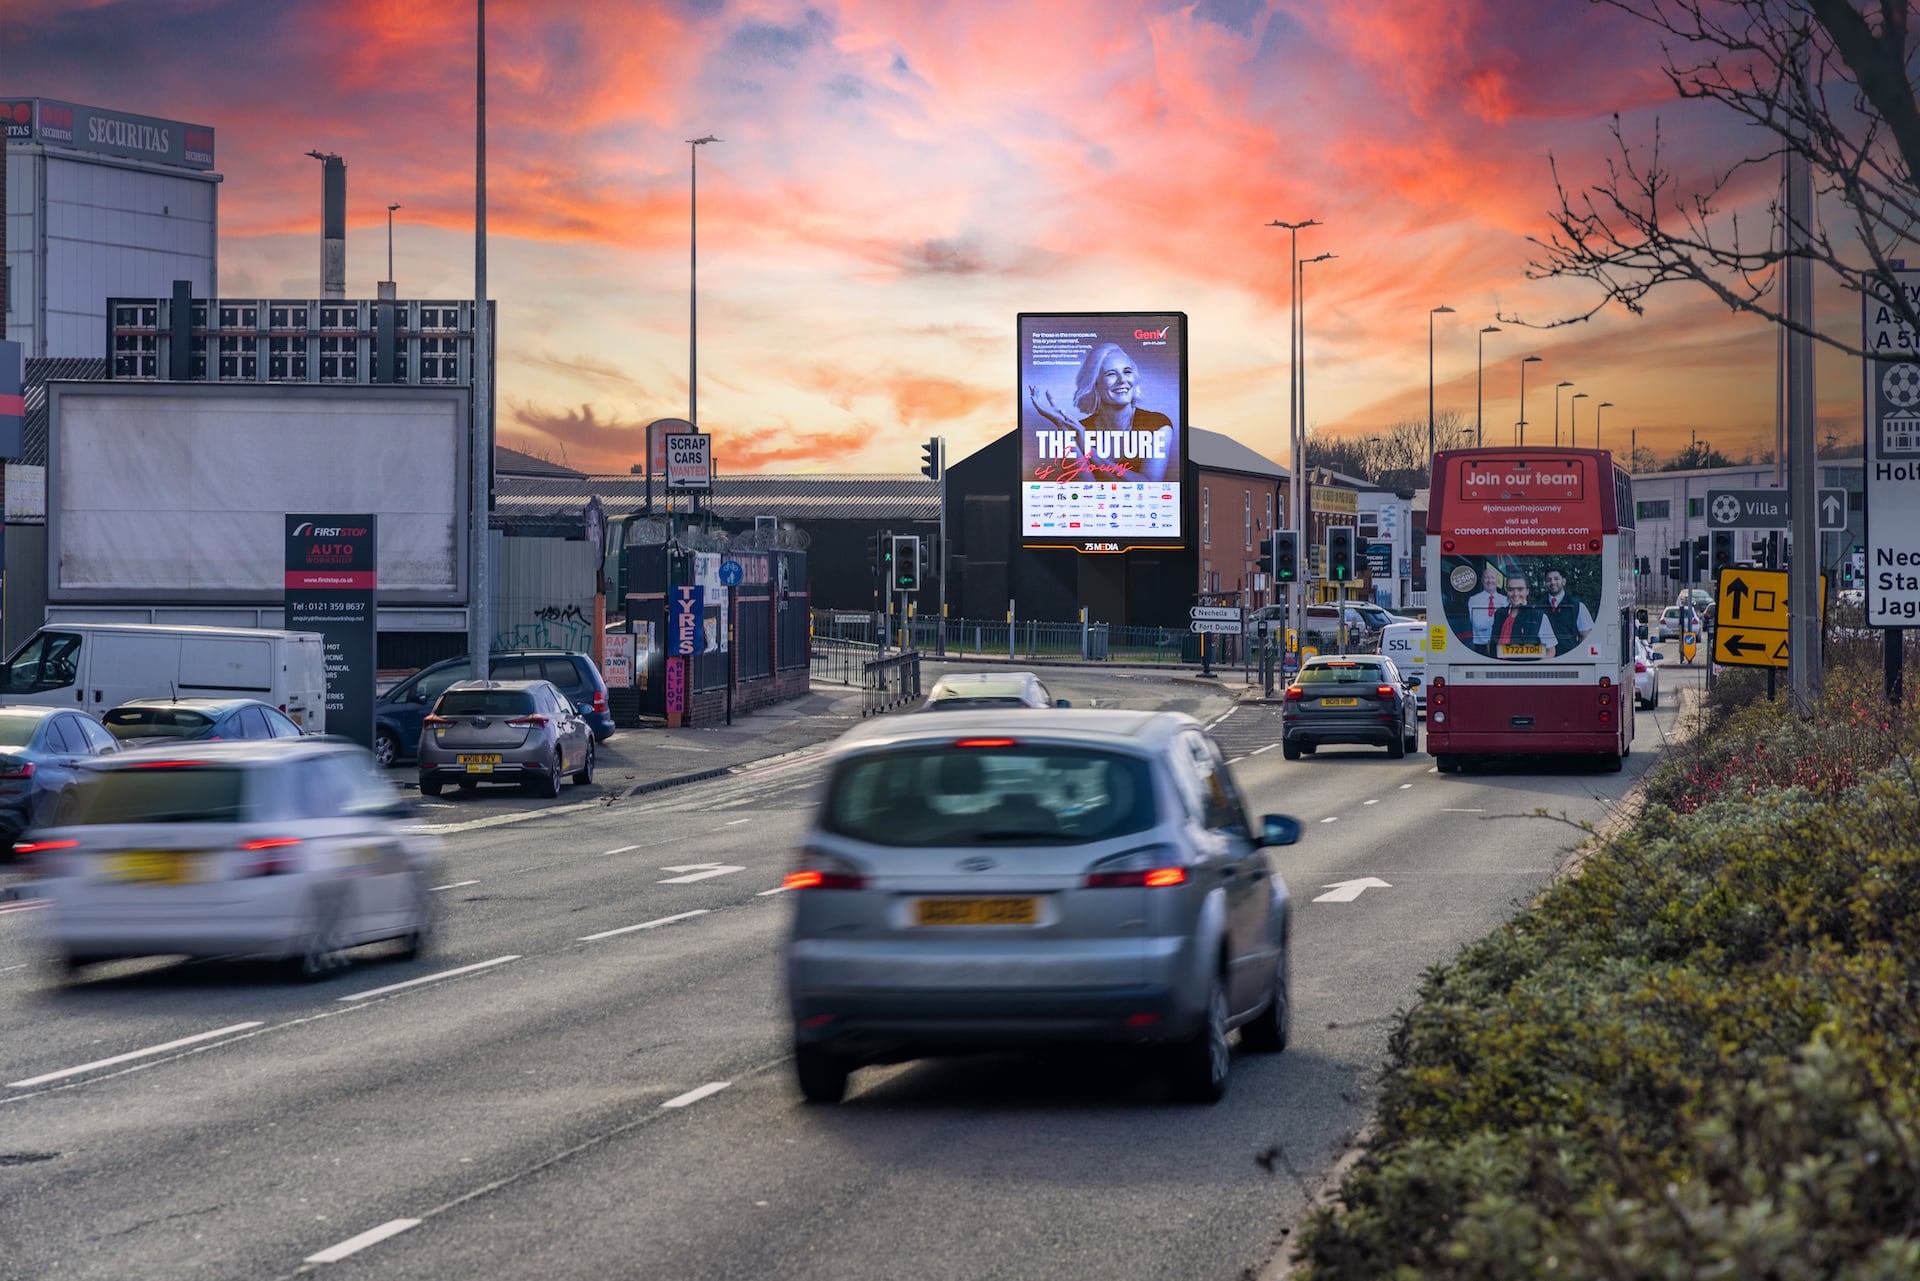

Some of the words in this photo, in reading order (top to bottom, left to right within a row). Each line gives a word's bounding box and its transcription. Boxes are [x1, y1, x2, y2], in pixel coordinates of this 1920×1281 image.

[41, 127, 72, 141] SECURITAS
[88, 116, 170, 153] SECURITAS
[670, 438, 706, 450] SCRAP
[1036, 430, 1077, 459] THE
[1084, 430, 1166, 459] FUTURE
[674, 452, 702, 464] CARS
[670, 465, 707, 477] WANTED
[1034, 462, 1055, 480] is
[1466, 471, 1500, 485] Join
[1505, 474, 1532, 485] our
[1535, 472, 1578, 485] team
[1482, 504, 1562, 513] #joinusonthejourney
[1745, 502, 1778, 515] Villa
[314, 527, 367, 537] FIRSTSTOP
[1454, 526, 1589, 537] careers.nationalexpress.com
[311, 544, 353, 555] AUTO
[1567, 543, 1586, 551] 4131
[308, 602, 328, 611] 0121
[329, 602, 344, 611] 359
[345, 602, 365, 611] 8637
[1877, 597, 1920, 618] Jag
[1198, 609, 1227, 617] Nechells
[677, 585, 696, 655] TYRES
[1215, 623, 1239, 631] Dunlop
[605, 636, 629, 647] RAP
[1389, 639, 1412, 651] SSL
[326, 664, 351, 672] ANICAL
[667, 665, 675, 707] ALLOY
[327, 692, 345, 700] ERIES
